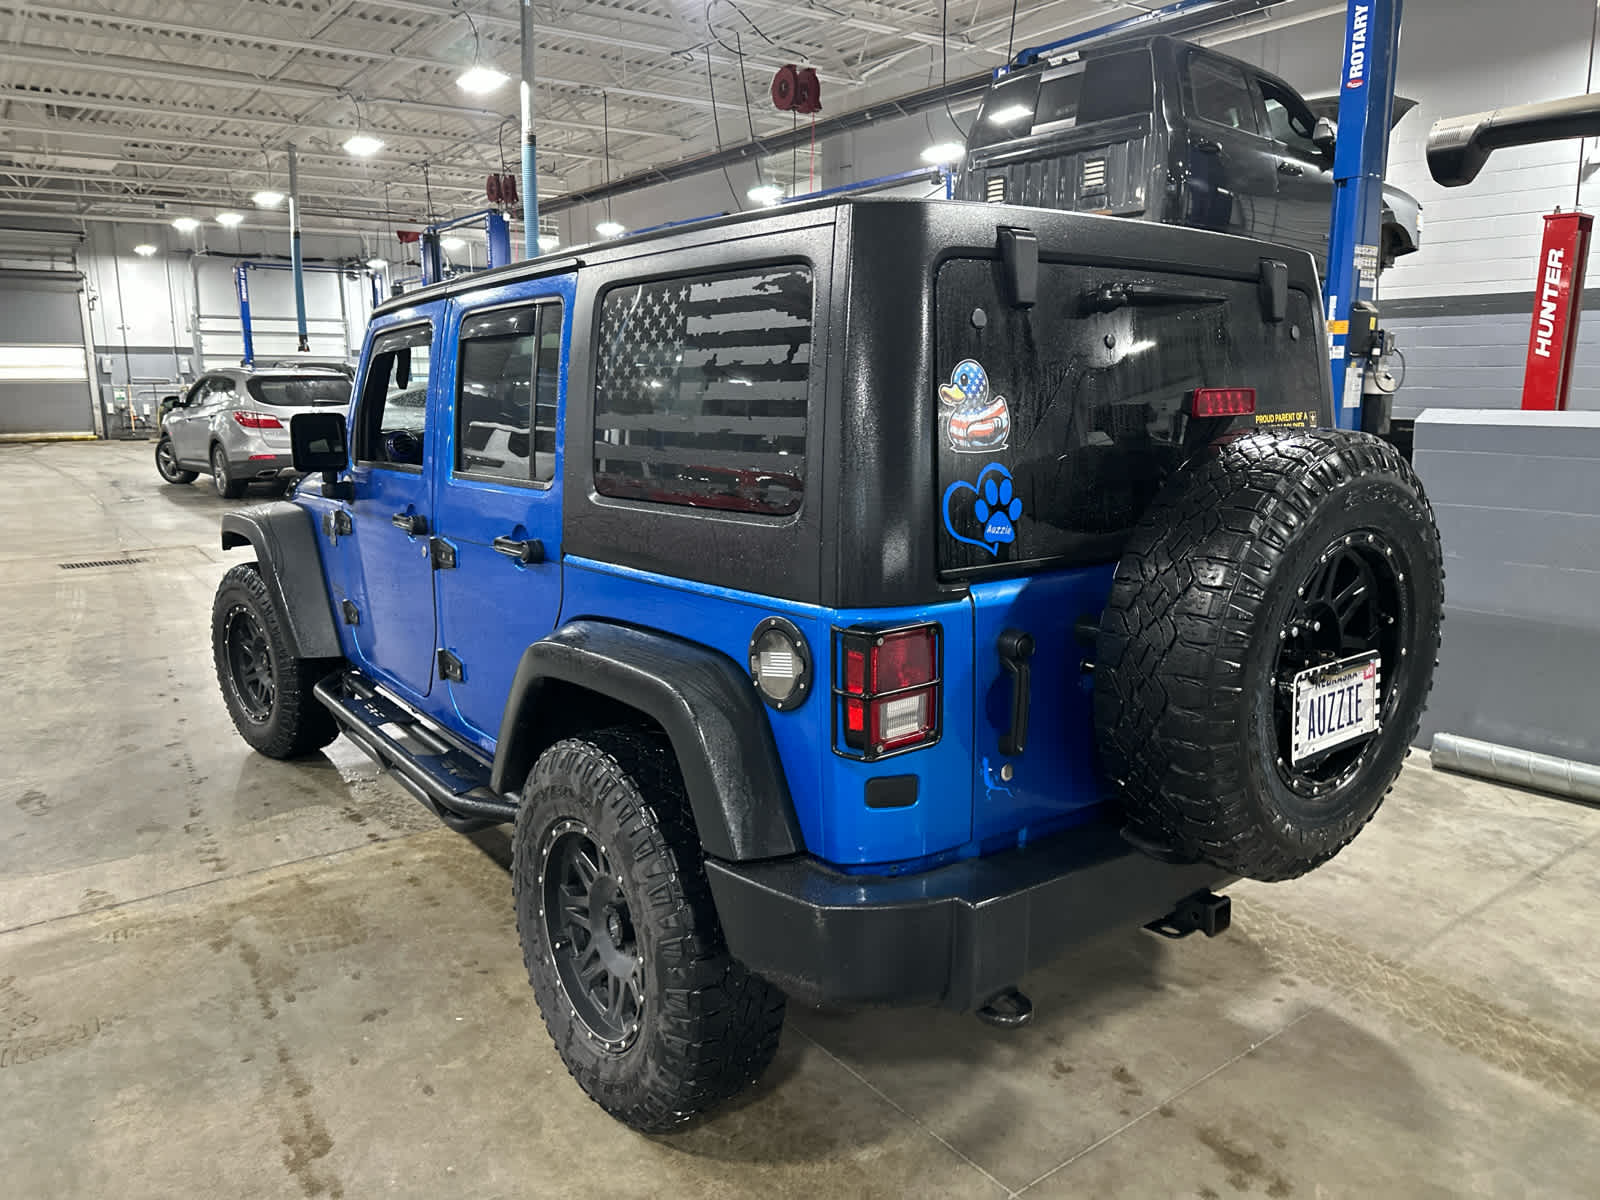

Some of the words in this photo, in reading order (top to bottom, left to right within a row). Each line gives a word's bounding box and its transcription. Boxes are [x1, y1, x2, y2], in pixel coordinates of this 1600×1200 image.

[1349, 5, 1368, 79] ROTARY
[1535, 248, 1564, 358] HUNTER
[1255, 414, 1274, 424] PROUD
[1275, 412, 1295, 423] PARENT
[1296, 411, 1303, 421] OF
[1303, 411, 1308, 420] A
[1308, 682, 1363, 741] AUZZIE
